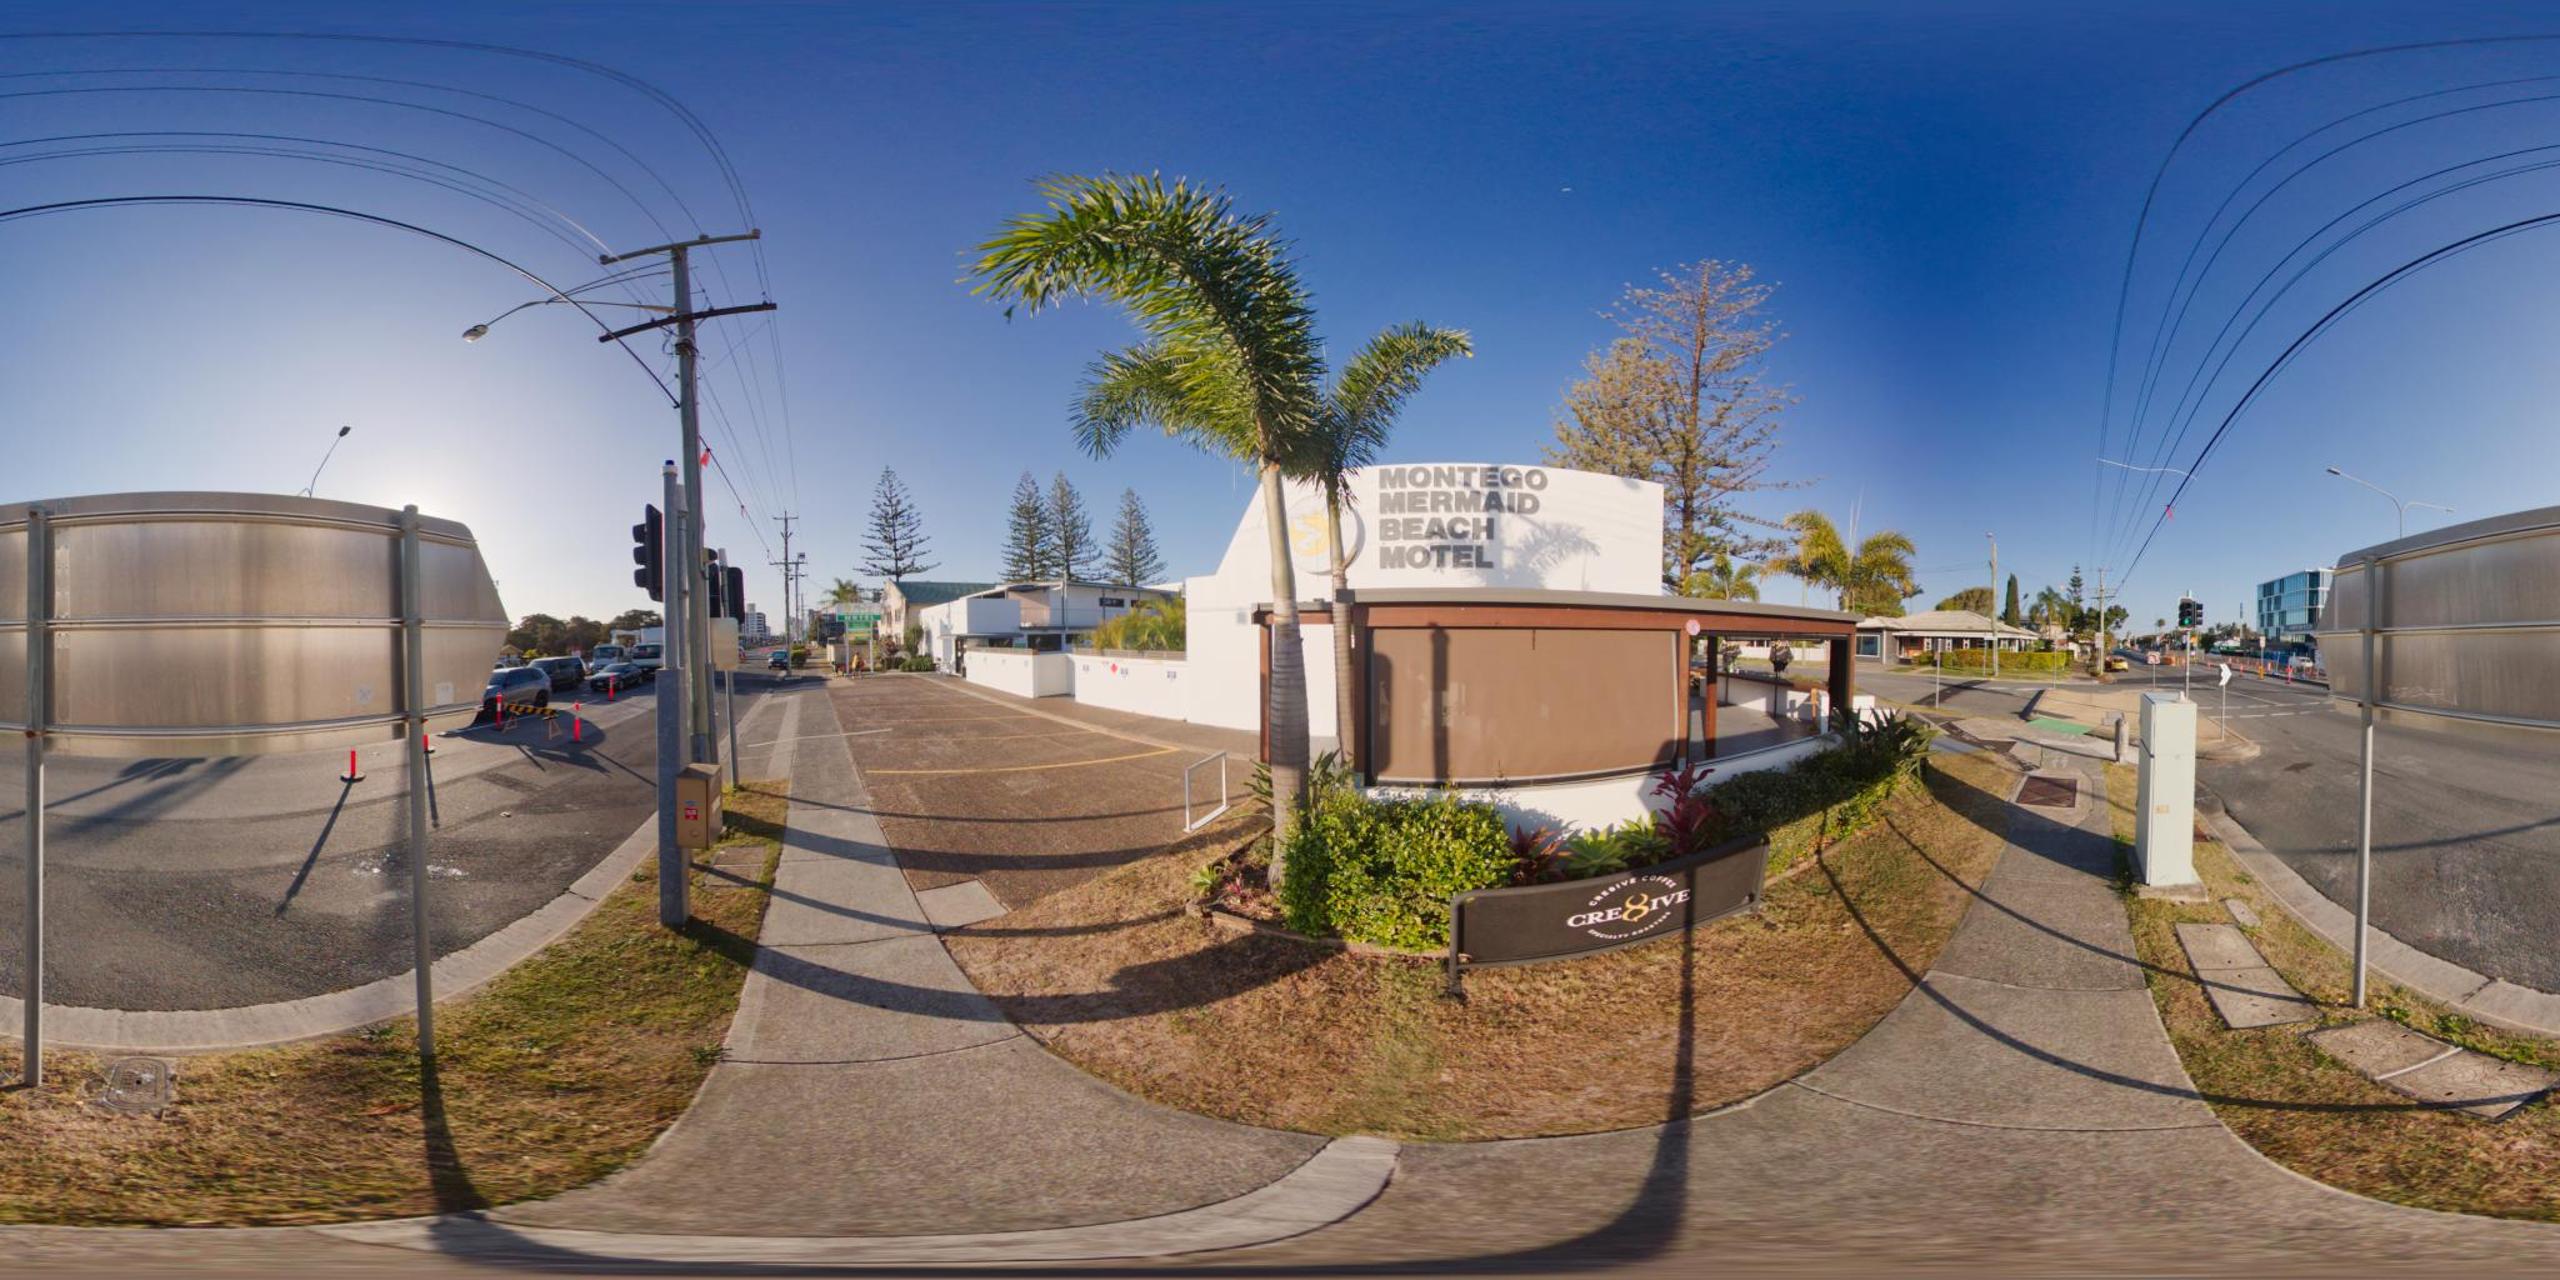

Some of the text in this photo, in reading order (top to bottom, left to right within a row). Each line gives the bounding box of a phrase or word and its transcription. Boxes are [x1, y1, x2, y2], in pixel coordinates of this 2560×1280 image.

[1379, 466, 1548, 491] MONTEGO
[1379, 491, 1540, 514] MERMAID
[1379, 517, 1495, 541] BEACH
[1379, 545, 1494, 569] MOTEL
[1641, 875, 1677, 888] COFFEE
[1567, 889, 1690, 927] CRE8IVE
